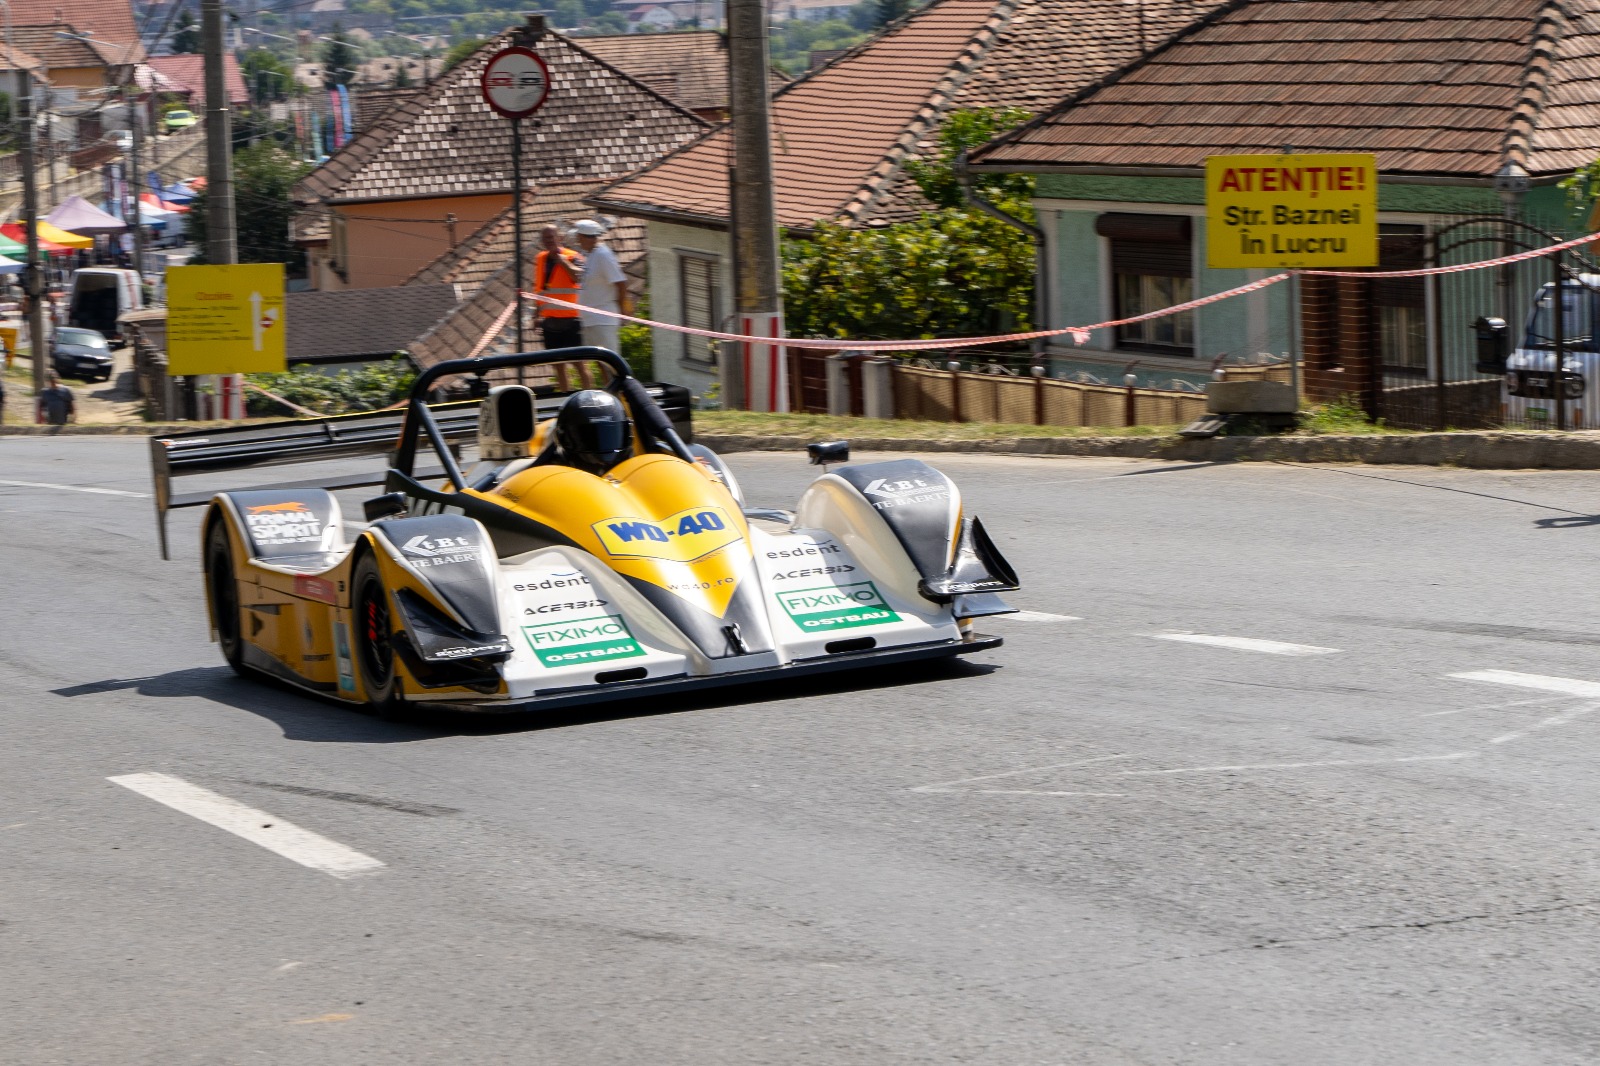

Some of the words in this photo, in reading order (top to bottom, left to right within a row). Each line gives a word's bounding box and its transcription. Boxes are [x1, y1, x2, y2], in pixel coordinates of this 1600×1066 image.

[1218, 167, 1366, 198] ATENȚIE!
[1223, 205, 1267, 225] Str.
[1272, 203, 1361, 225] Baznei
[1239, 228, 1265, 254] În
[1271, 234, 1347, 254] Lucru
[252, 522, 321, 539] SPIRIT
[607, 511, 725, 543] WD-40
[766, 544, 841, 559] esdent
[513, 575, 591, 592] esdent
[786, 590, 875, 610] FIXIMO
[803, 611, 891, 628] OSTBAU
[531, 623, 623, 645] FIXIMO
[545, 645, 636, 662] OSTBAU
